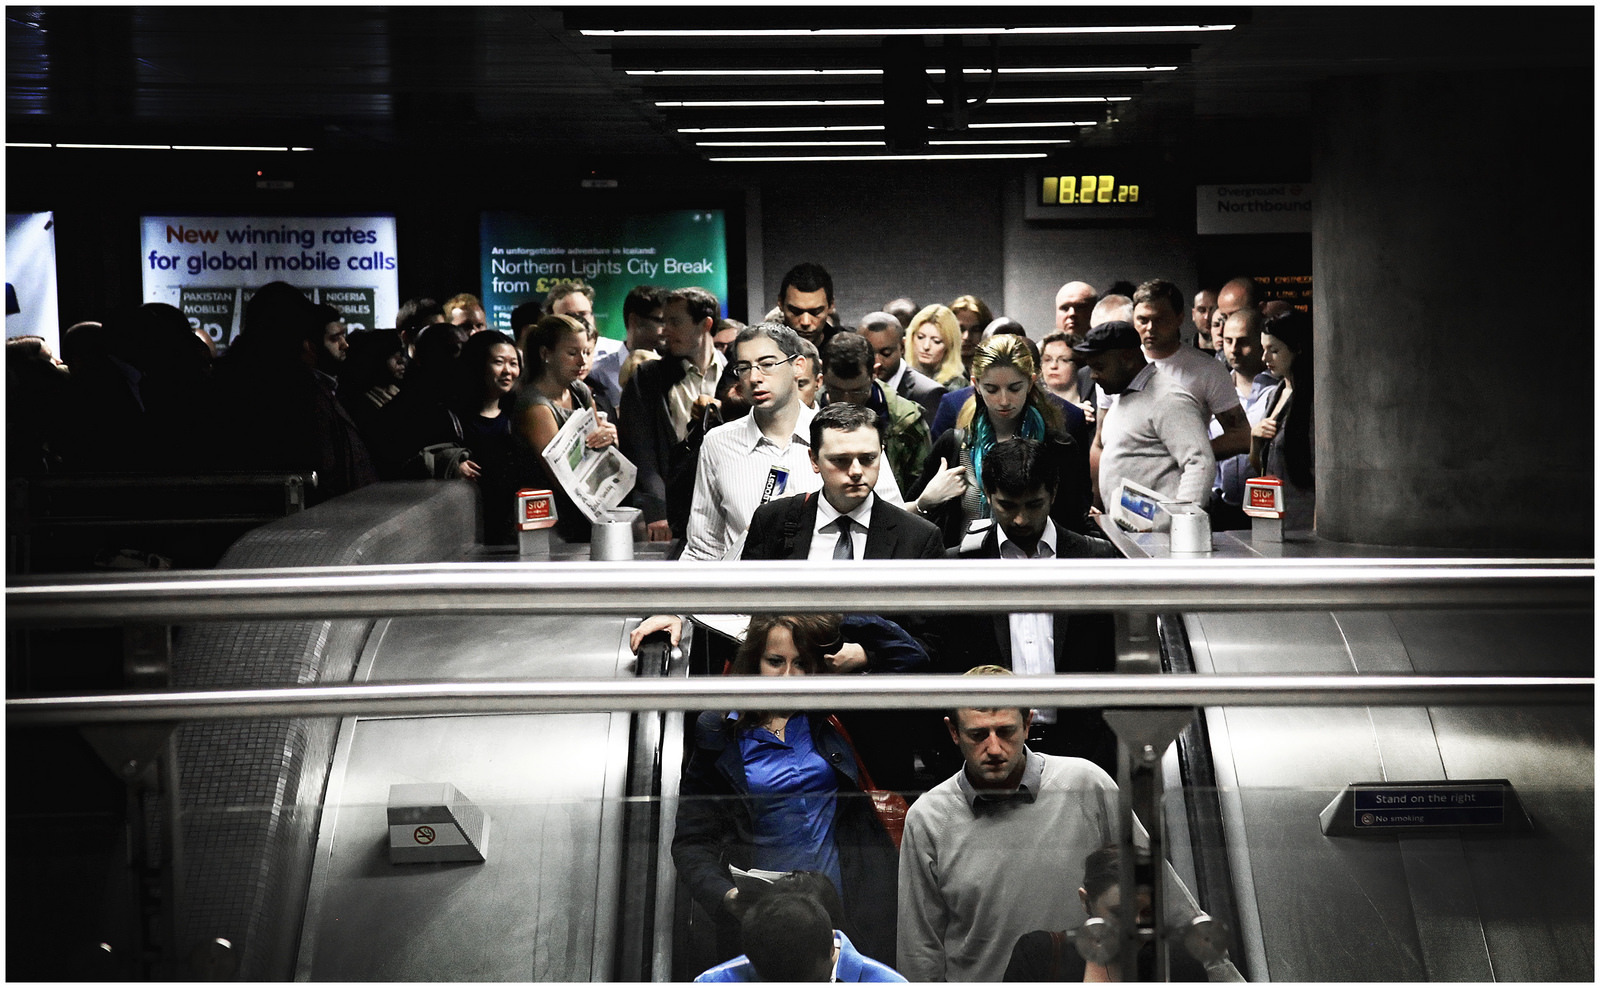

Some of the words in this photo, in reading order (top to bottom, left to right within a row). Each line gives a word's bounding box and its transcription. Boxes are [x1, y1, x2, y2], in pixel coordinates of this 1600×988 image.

[1217, 186, 1285, 197] Overground
[1217, 200, 1312, 213] Northbound
[166, 225, 219, 244] New
[226, 225, 315, 248] winning
[322, 226, 377, 244] rates
[491, 246, 504, 255] An
[506, 246, 566, 256] unforgettable
[567, 246, 610, 255] adventure
[612, 246, 621, 255] in
[148, 250, 181, 270] for
[187, 251, 257, 275] global
[265, 251, 340, 270] mobile
[347, 251, 396, 270] calls
[491, 258, 566, 275] Northern
[571, 257, 622, 279] Lights
[627, 257, 659, 279] City
[664, 257, 714, 274] Break
[491, 276, 530, 293] from
[183, 292, 232, 301] PAKISTAN
[326, 292, 367, 301] NIGERIA
[183, 305, 228, 314] MOBILES
[336, 304, 371, 314] OBILES
[1253, 489, 1273, 498] STOP
[528, 500, 547, 510] STOP
[1375, 794, 1407, 804] Stand
[1410, 795, 1425, 803] on
[1428, 793, 1447, 803] the
[1450, 793, 1477, 804] right
[1390, 814, 1425, 823] smoking
